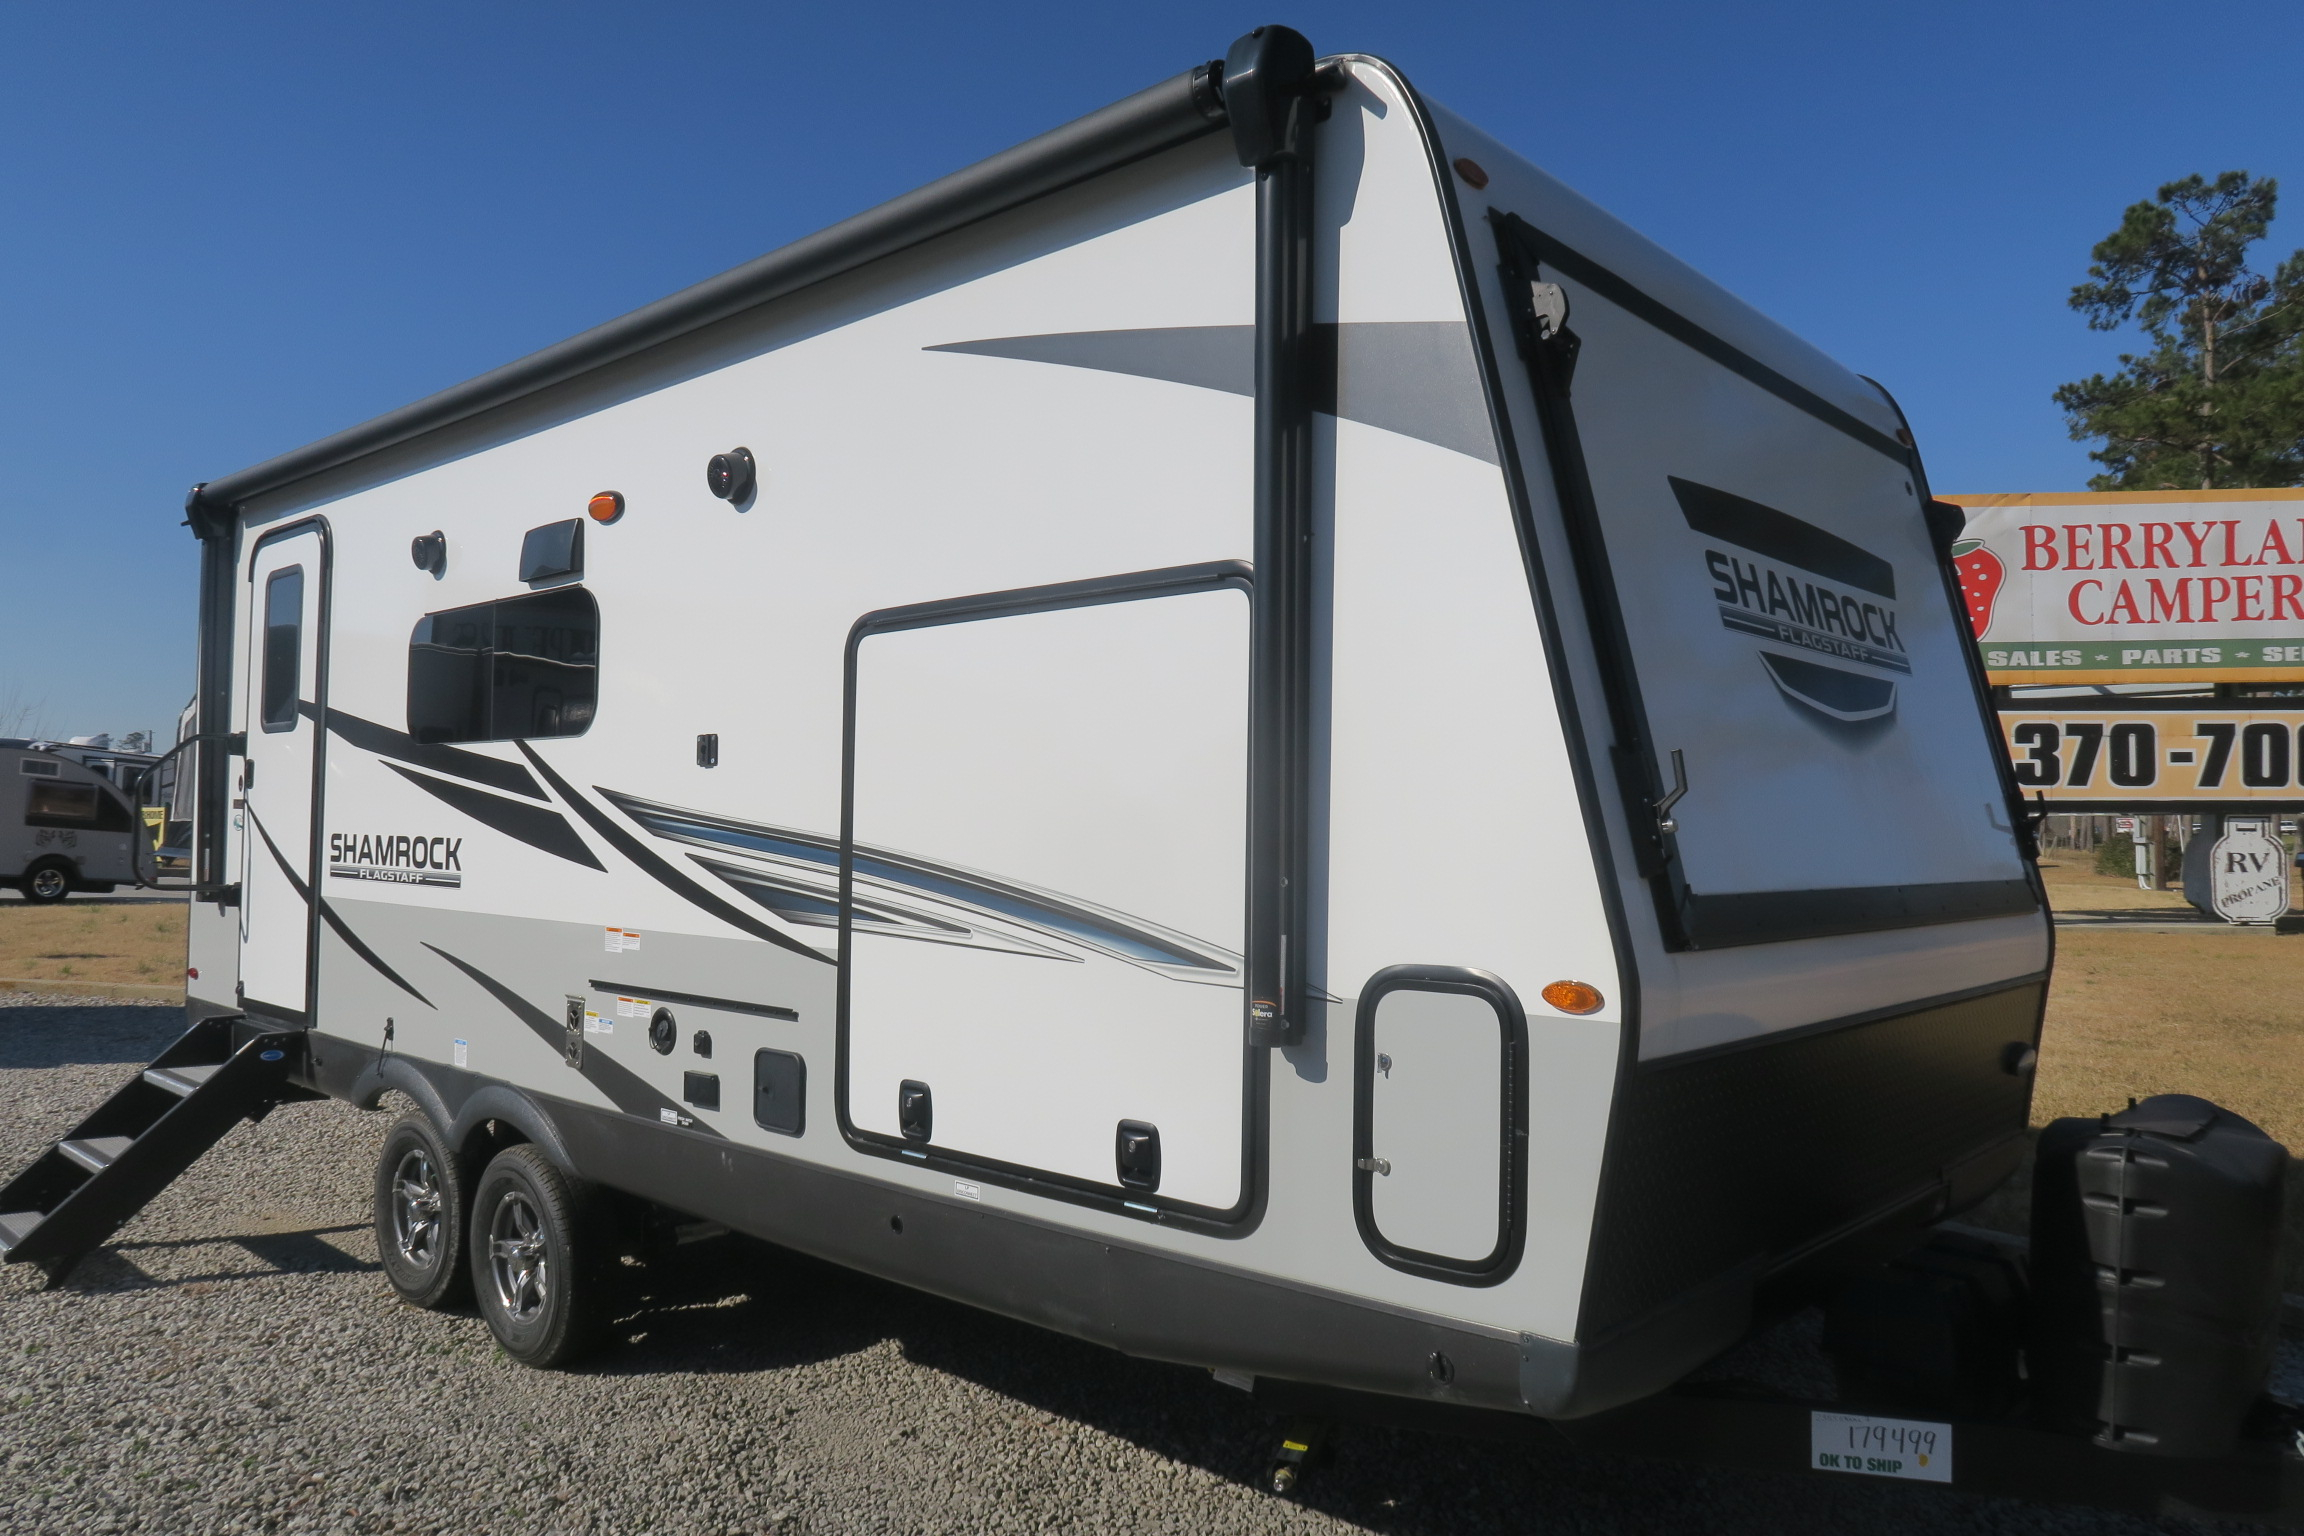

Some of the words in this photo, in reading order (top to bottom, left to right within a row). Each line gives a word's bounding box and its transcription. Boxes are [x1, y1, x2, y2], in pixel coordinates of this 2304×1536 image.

[2018, 518, 2304, 571] BERRYLA
[1705, 549, 1905, 652] SHAMROCK
[1777, 625, 1869, 661] FLAGSTAFF
[1988, 650, 2082, 667] SALES
[2122, 647, 2222, 665] PARTS
[2262, 646, 2304, 662] SE
[2013, 722, 2304, 788] 370-70
[330, 833, 462, 871] SHAMROCK
[2225, 852, 2270, 873] RV
[359, 868, 423, 883] FLAGSTAFF
[2221, 876, 2280, 908] PROPANE
[1849, 1425, 1936, 1454] 179499
[1819, 1452, 1840, 1468] OK
[1844, 1455, 1862, 1470] TO
[1867, 1457, 1902, 1473] SHIP
